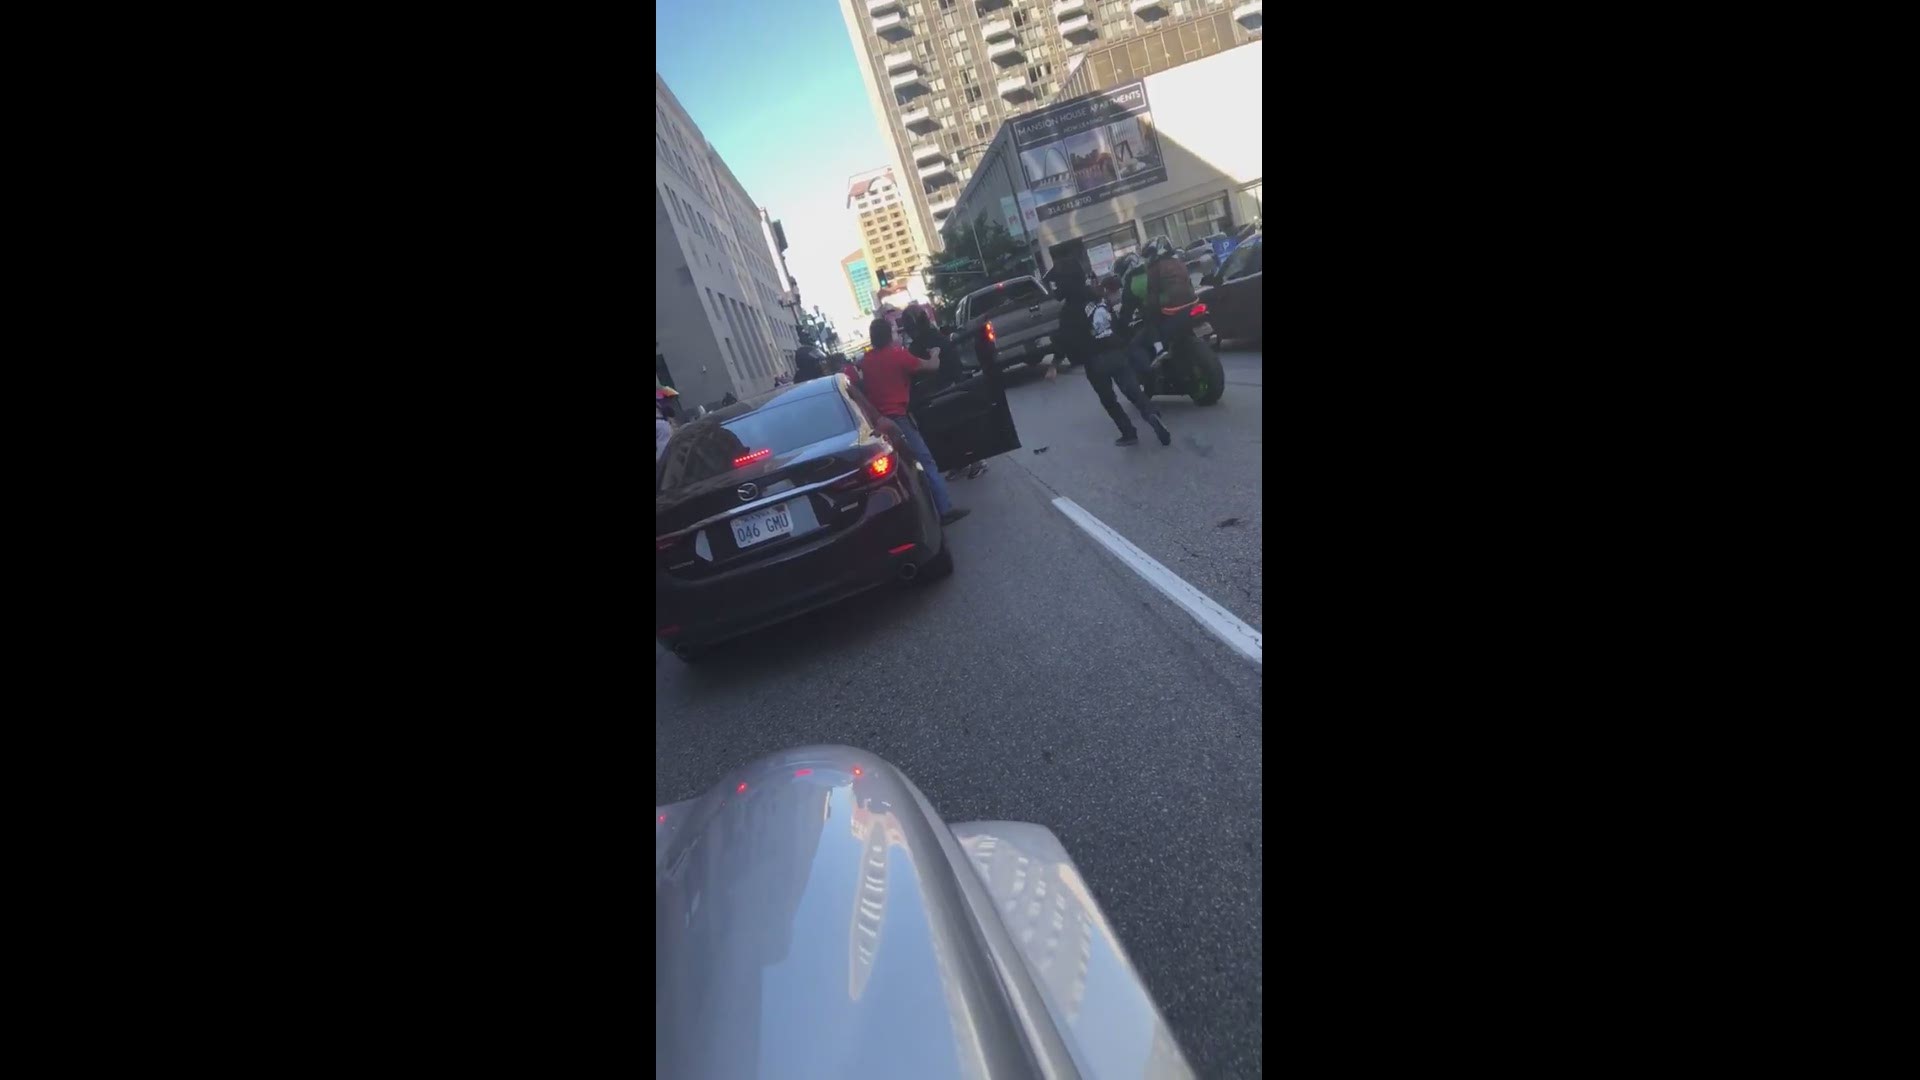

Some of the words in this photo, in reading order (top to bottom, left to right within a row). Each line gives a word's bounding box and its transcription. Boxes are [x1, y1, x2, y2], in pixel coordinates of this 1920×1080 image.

[1018, 117, 1059, 135] MANSION
[1060, 108, 1087, 122] HOUSE
[1090, 90, 1141, 112] APARTMENTS
[737, 523, 760, 542] 046
[765, 512, 789, 532] GMU
